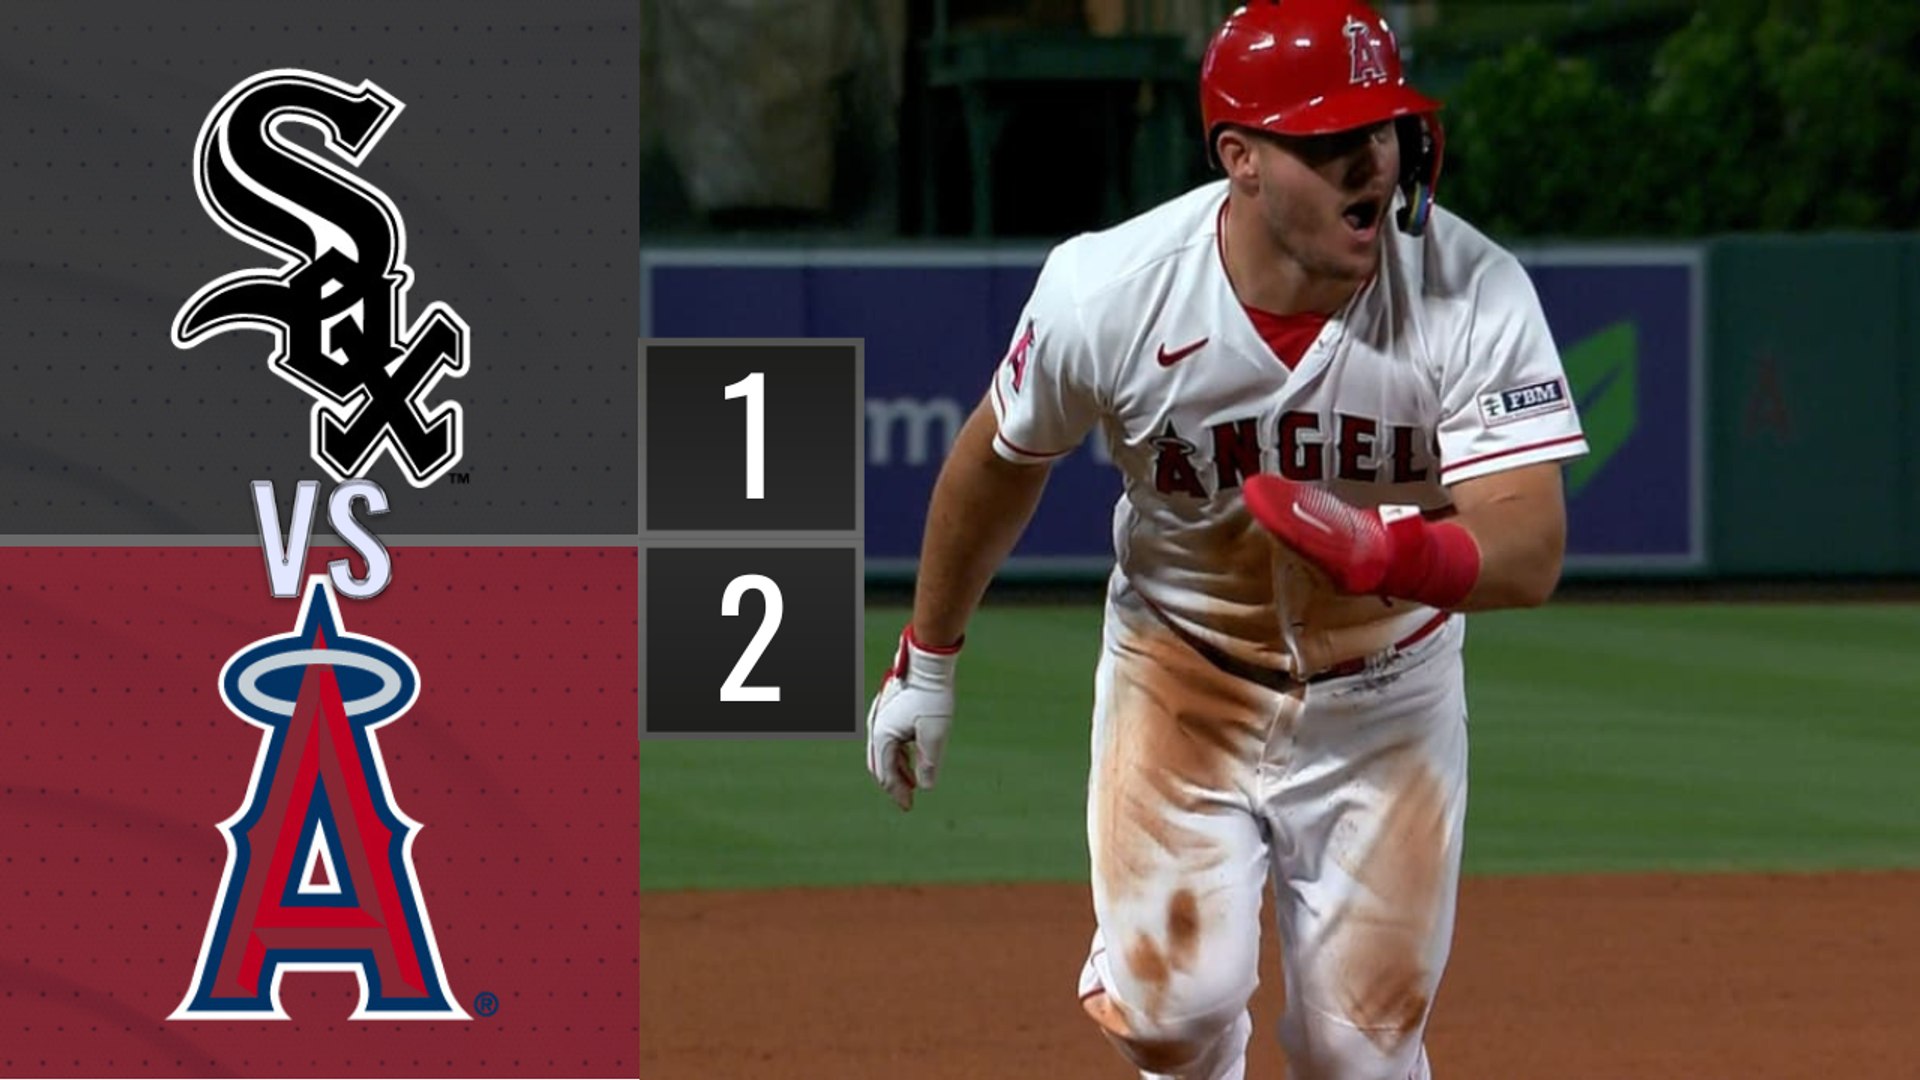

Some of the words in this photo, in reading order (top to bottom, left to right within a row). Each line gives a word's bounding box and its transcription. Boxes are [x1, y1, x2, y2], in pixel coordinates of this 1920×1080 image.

[1342, 14, 1387, 84] A
[1507, 384, 1559, 409] FBM
[1150, 410, 1440, 499] ANGEL
